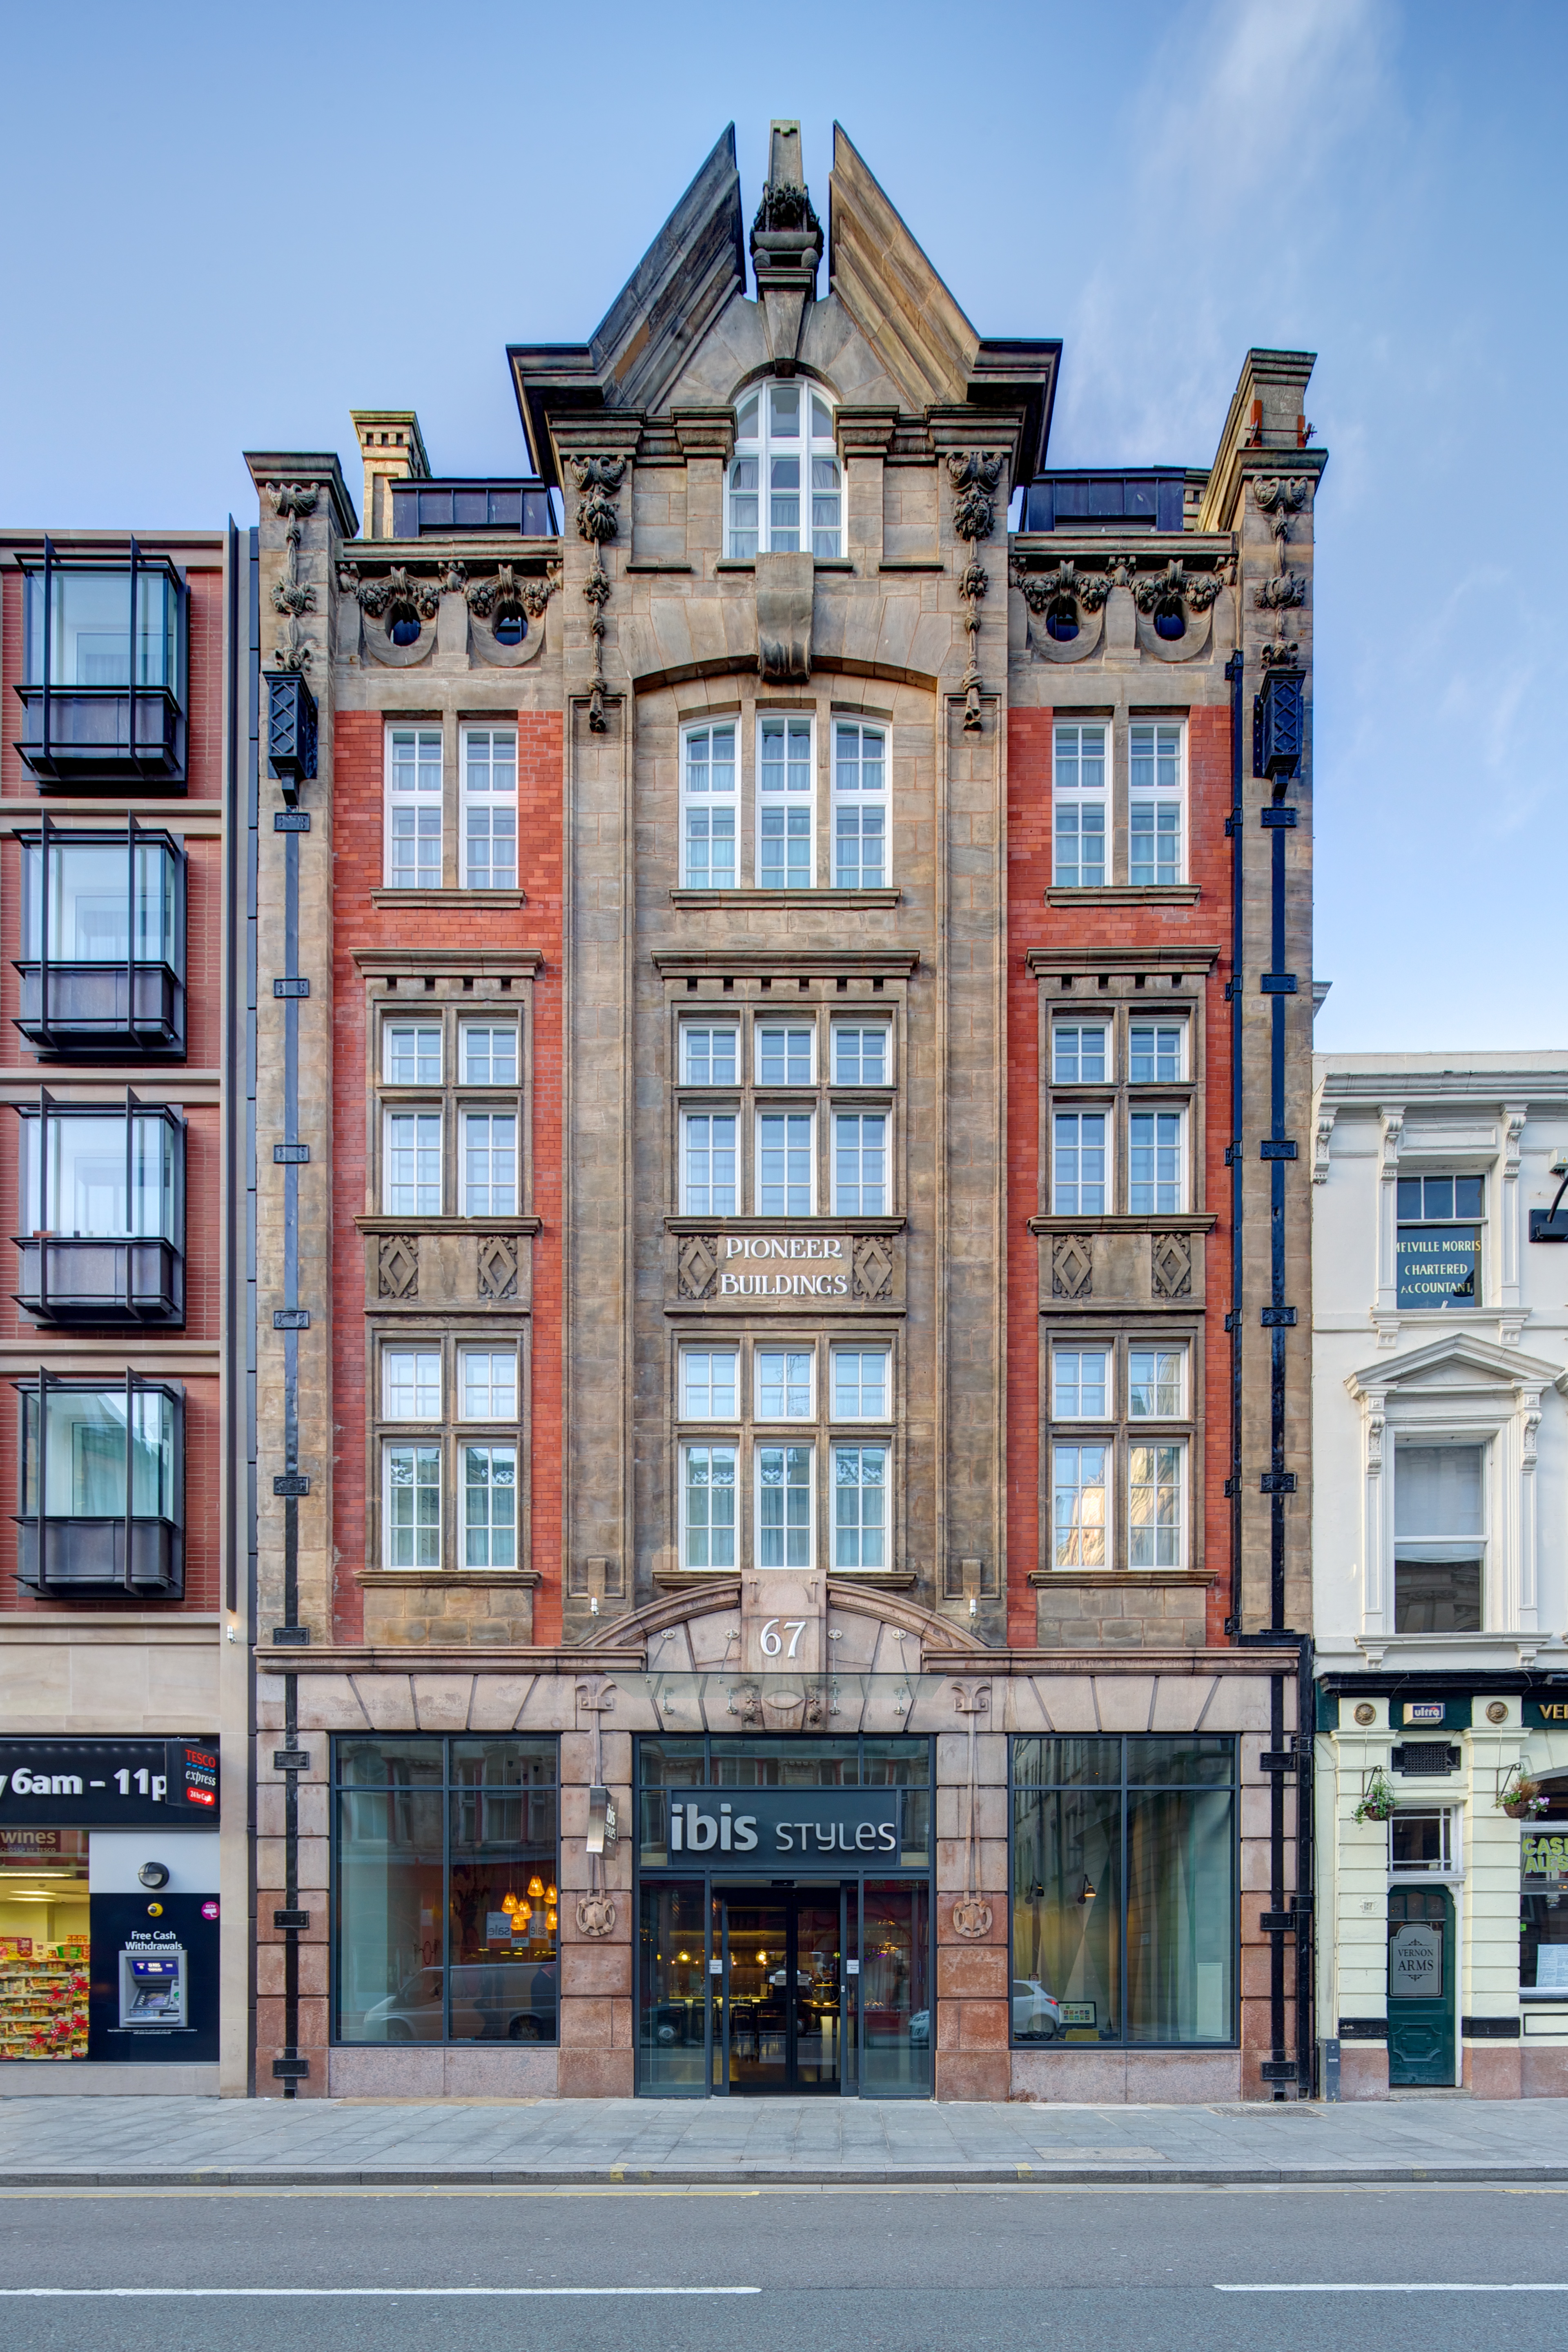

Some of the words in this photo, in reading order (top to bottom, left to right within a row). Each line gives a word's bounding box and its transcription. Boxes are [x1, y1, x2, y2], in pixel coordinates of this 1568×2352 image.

[726, 1238, 843, 1259] PIONEER
[1442, 1240, 1481, 1252] MORRIS
[1405, 1263, 1468, 1275] CHARTERED
[720, 1274, 848, 1295] BUILDINGS
[1401, 1282, 1470, 1294] ACCOUNTANT
[760, 1618, 806, 1658] 67
[1414, 1707, 1440, 1717] ultra
[185, 1749, 216, 1768] TESCO
[11, 1768, 83, 1795] 6am
[185, 1771, 216, 1786] express
[201, 1793, 212, 1802] Cash
[606, 1803, 616, 1826] ibis
[672, 1803, 758, 1851] ibis
[775, 1822, 896, 1851] STYLES
[0, 1830, 56, 1844] wines
[1525, 1855, 1568, 1873] ALES
[131, 1931, 151, 1940] Free
[153, 1931, 176, 1940] Cash
[125, 1941, 183, 1950] Withdrawals
[1397, 1960, 1434, 1971] ARMS
